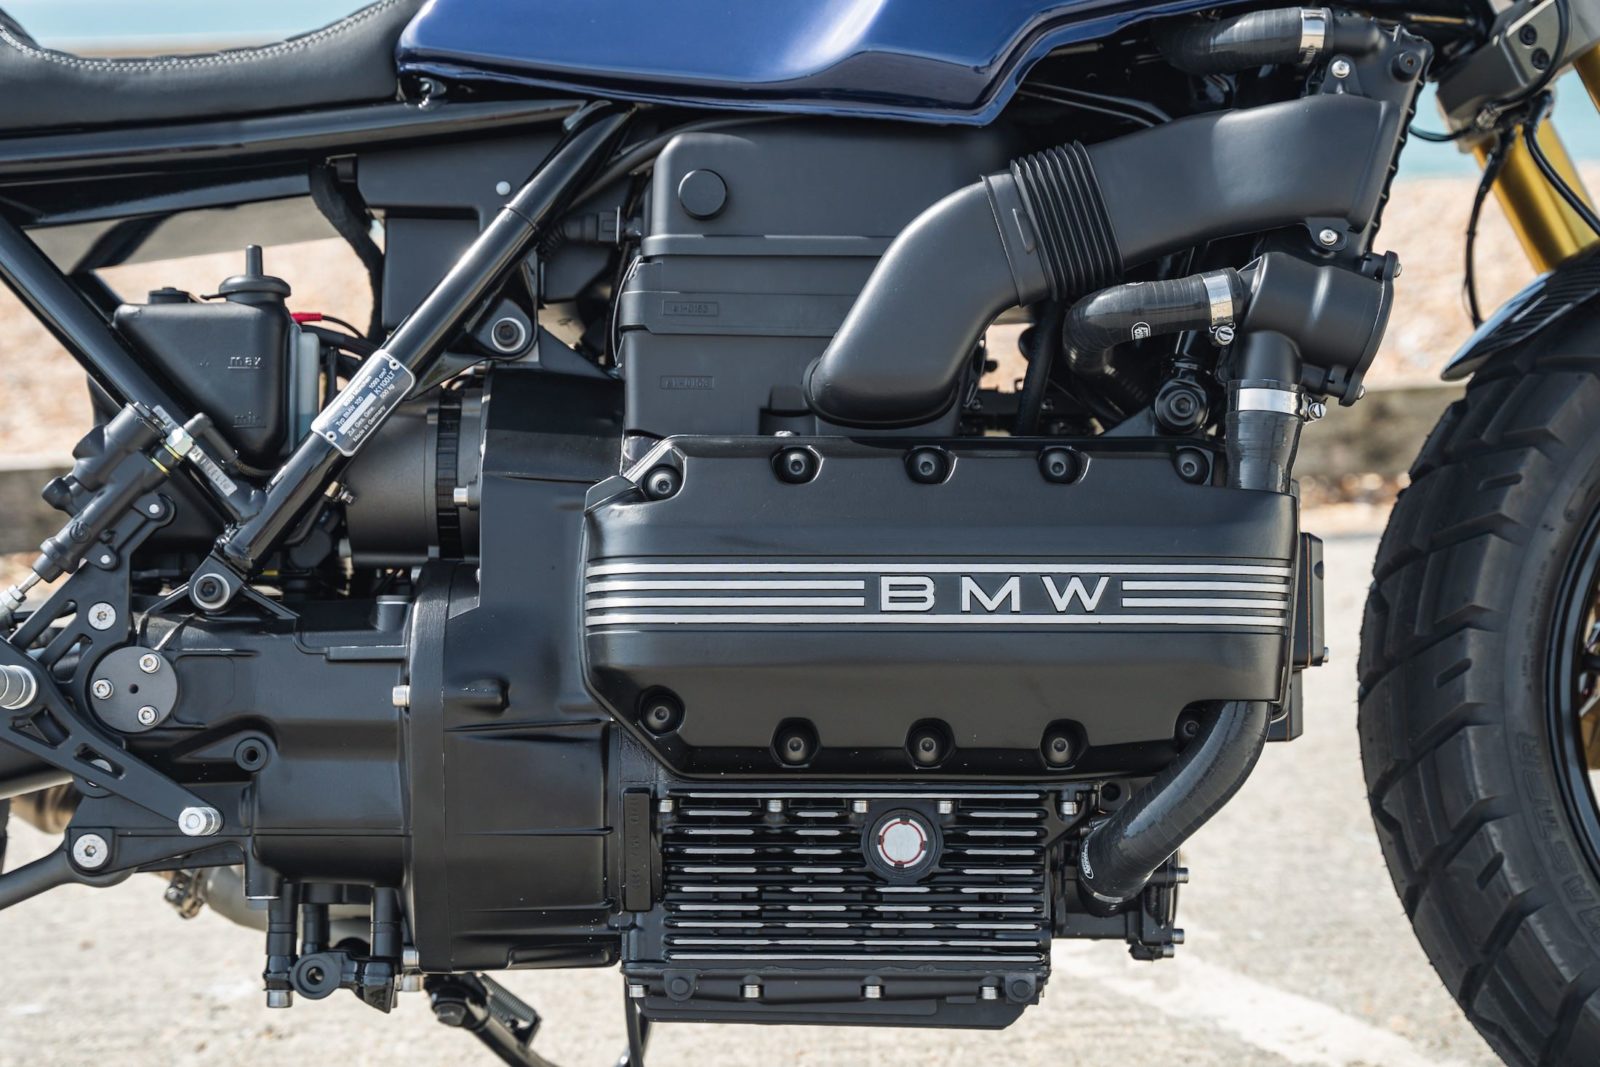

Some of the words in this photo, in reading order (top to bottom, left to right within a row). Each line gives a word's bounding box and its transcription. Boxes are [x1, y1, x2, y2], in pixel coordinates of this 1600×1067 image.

[336, 417, 346, 428] Typ
[343, 404, 357, 419] BMW
[352, 428, 365, 443] Made
[367, 404, 387, 426] Germany
[880, 576, 1110, 613] BMW
